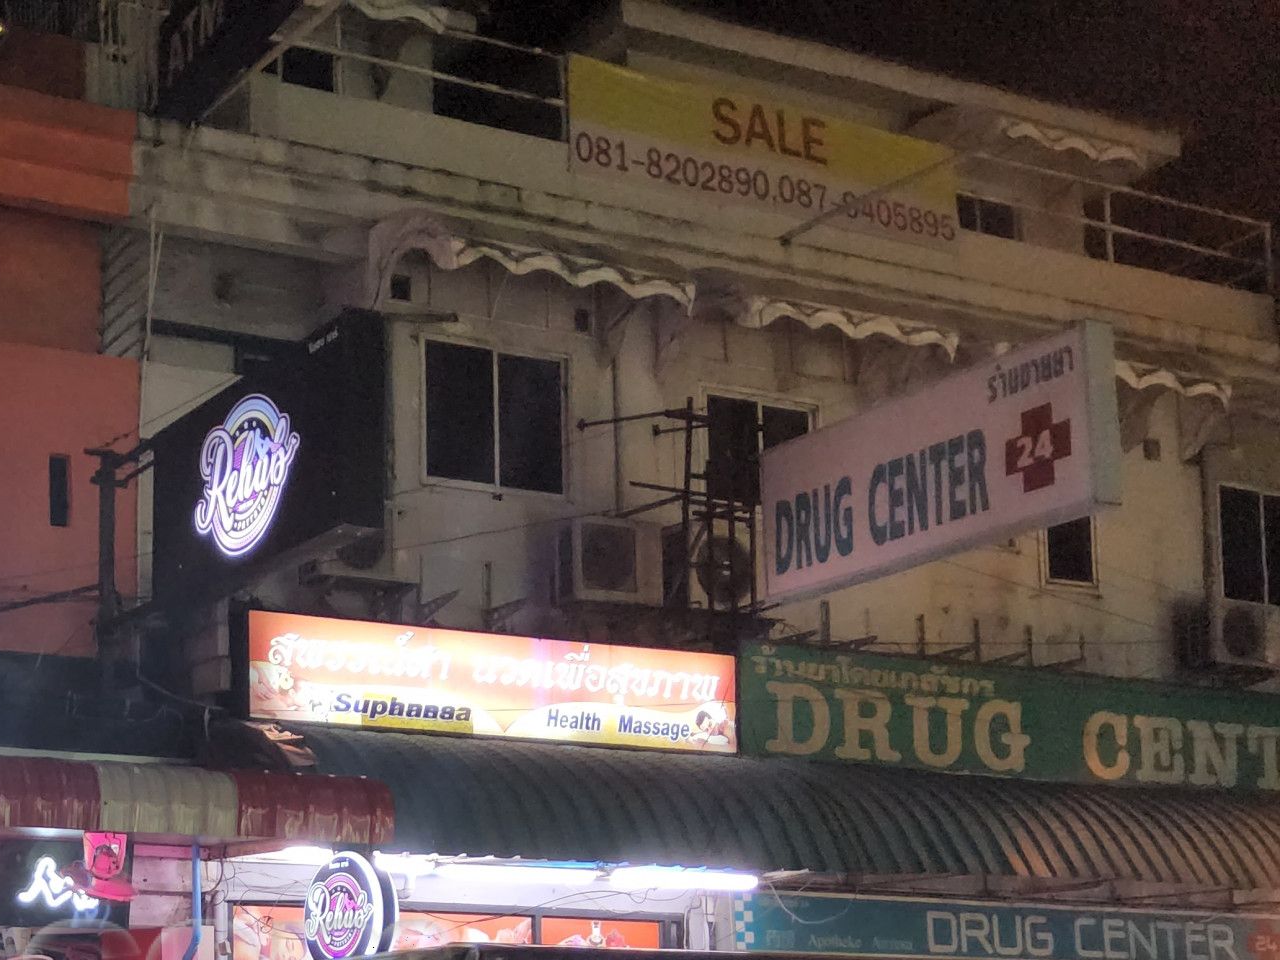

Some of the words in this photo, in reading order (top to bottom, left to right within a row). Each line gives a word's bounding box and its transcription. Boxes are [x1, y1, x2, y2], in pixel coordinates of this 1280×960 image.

[712, 97, 828, 166] SALE
[196, 414, 299, 532] Rehab
[1017, 429, 1053, 468] 24
[775, 476, 854, 576] DRUG
[869, 429, 989, 546] CENTER
[547, 709, 601, 732] Health
[618, 715, 690, 741] Massage
[765, 681, 1032, 773] DRUG
[305, 882, 374, 944] Rehab
[926, 910, 1054, 957] DRUG
